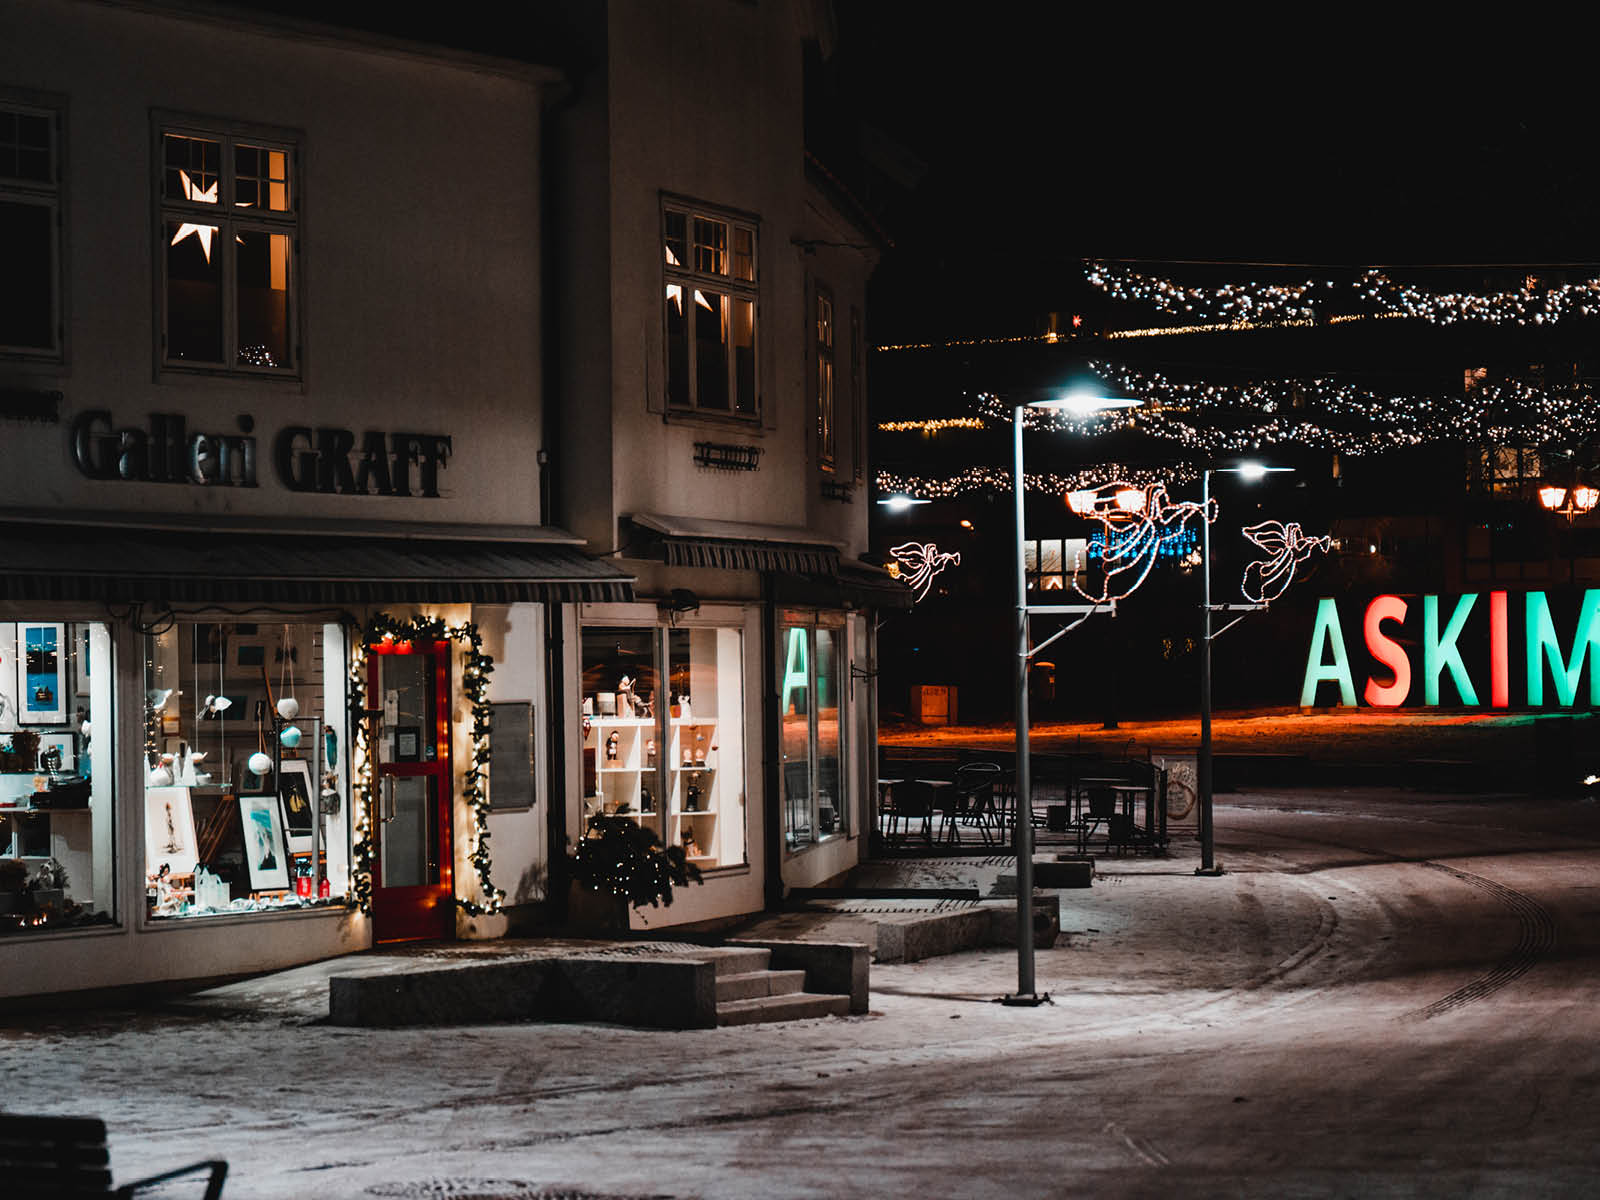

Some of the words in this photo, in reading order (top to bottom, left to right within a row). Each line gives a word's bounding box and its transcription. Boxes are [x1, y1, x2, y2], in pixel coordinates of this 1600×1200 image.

[72, 410, 257, 488] Galleri
[275, 427, 452, 497] GRAFF
[1300, 589, 1600, 708] ASKIM
